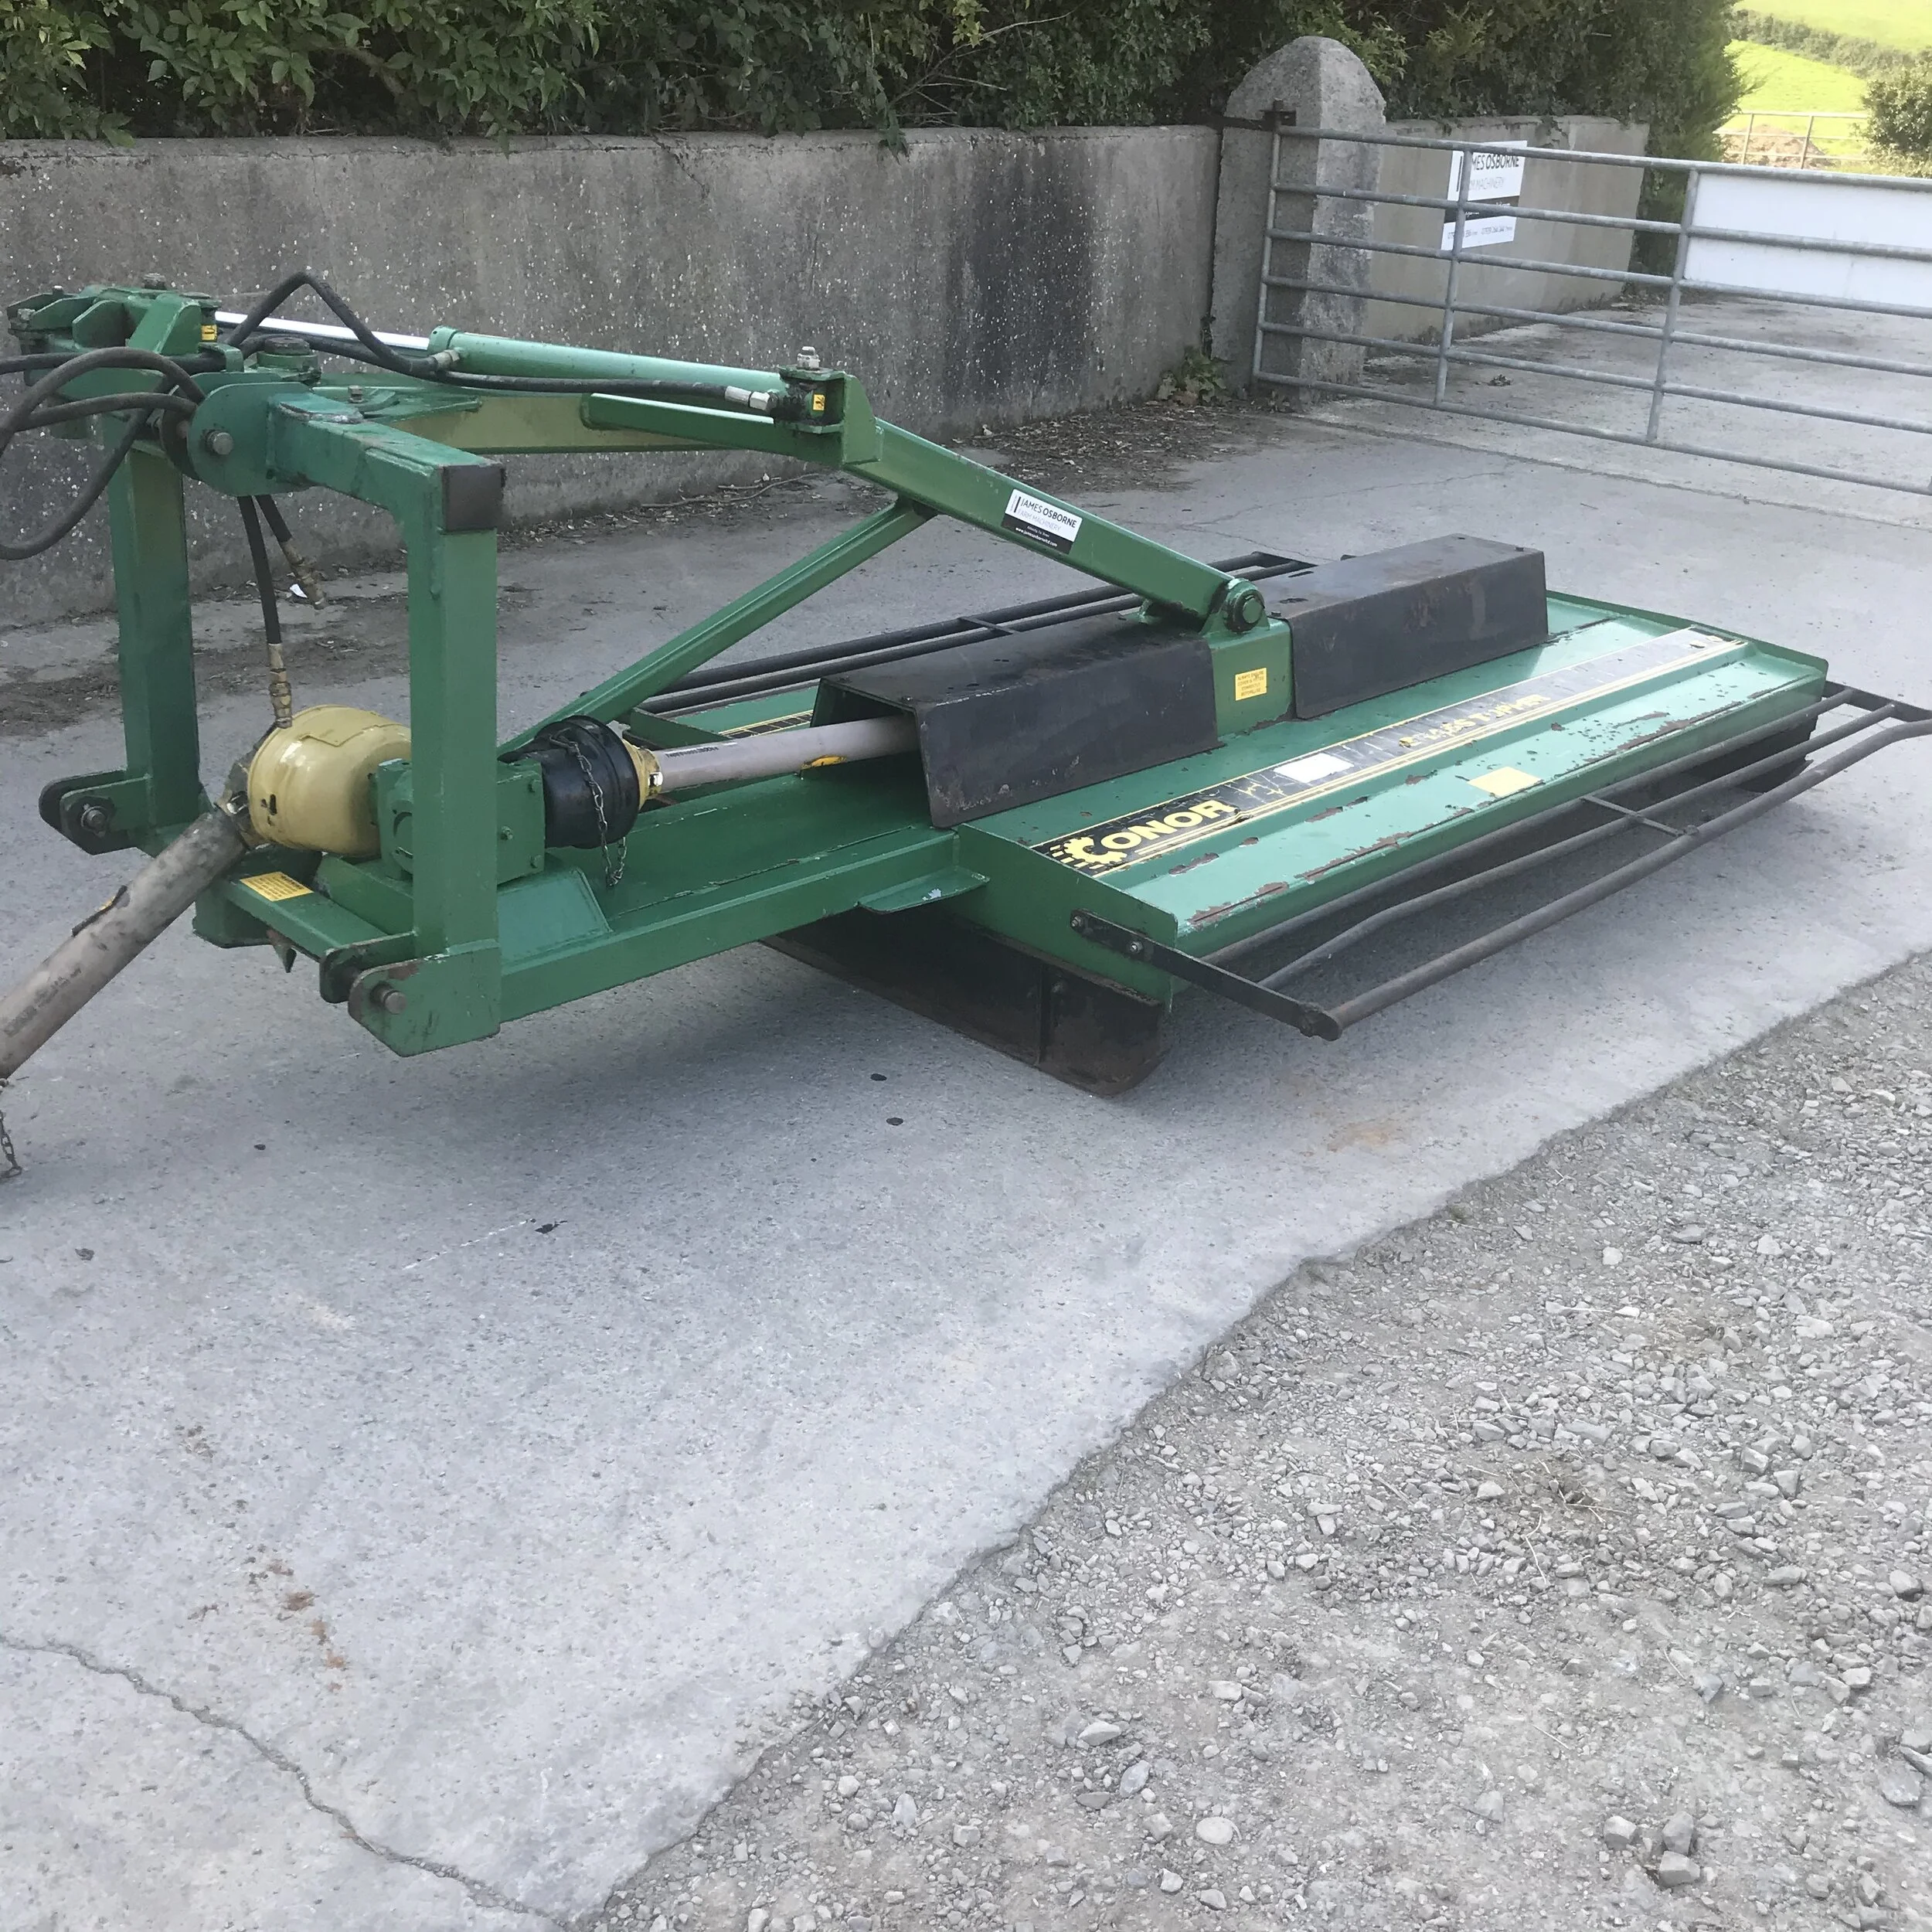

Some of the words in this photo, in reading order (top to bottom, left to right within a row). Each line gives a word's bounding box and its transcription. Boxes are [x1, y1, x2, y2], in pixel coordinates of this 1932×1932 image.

[1485, 154, 1519, 170] OSBORNE
[1021, 498, 1043, 514] JAMES
[1043, 508, 1077, 529] OSBORNE
[1063, 799, 1239, 865] CONOR
